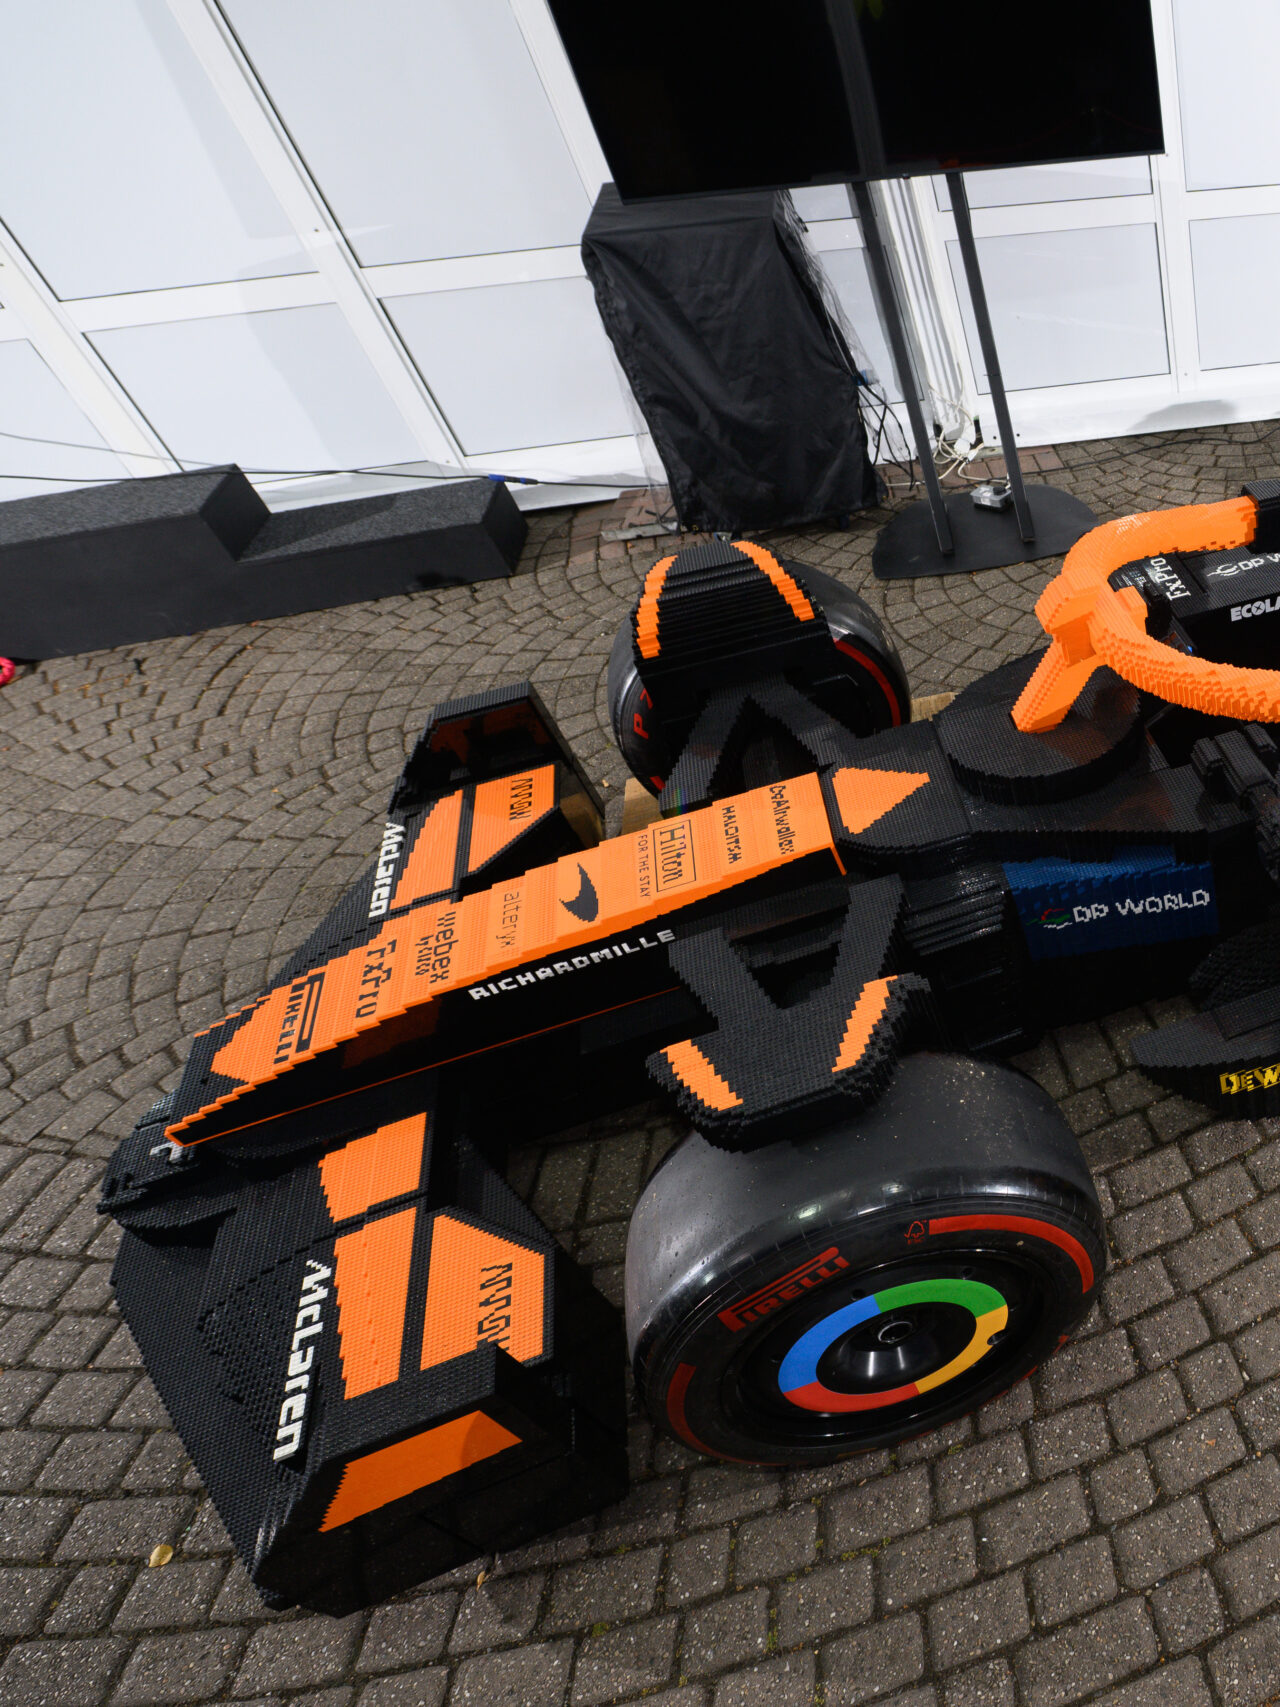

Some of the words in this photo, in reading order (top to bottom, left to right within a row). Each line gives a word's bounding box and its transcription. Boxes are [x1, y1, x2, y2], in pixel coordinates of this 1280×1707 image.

[1150, 557, 1191, 601] FxPro
[1238, 558, 1265, 571] DP
[368, 821, 407, 919] McLaren
[638, 834, 649, 856] FOR
[640, 855, 649, 875] THE
[659, 824, 687, 884] Hilton
[639, 876, 651, 898] STAY
[1072, 903, 1110, 923] DP
[1115, 889, 1211, 916] WORLD
[429, 911, 460, 984] webex
[273, 971, 326, 1066] PIRELLI
[716, 1246, 851, 1333] PIRELLI
[273, 1260, 332, 1461] McLaren
